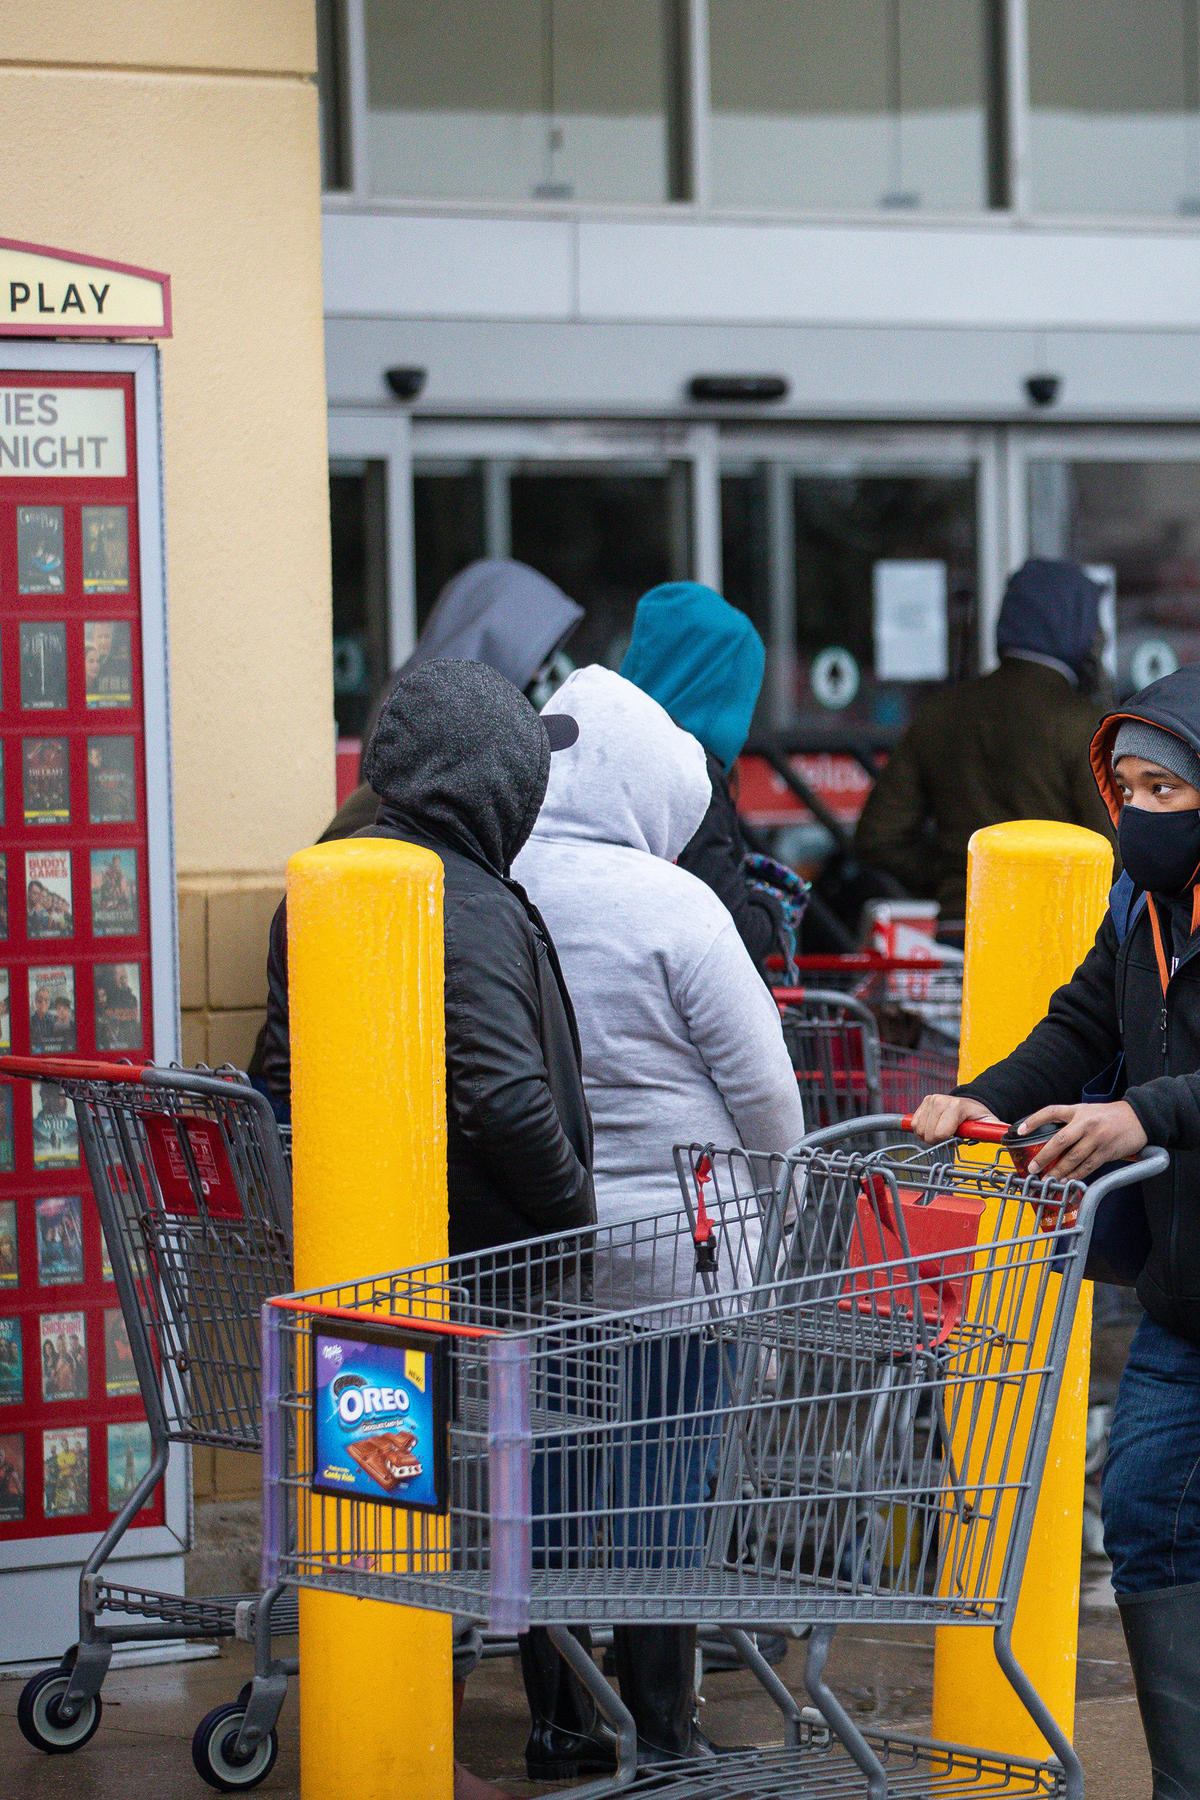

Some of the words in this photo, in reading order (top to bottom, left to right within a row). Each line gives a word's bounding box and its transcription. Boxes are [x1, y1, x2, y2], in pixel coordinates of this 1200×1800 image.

[10, 282, 111, 314] PLAY
[0, 392, 58, 426] IES
[0, 435, 108, 468] NIGHT
[28, 857, 67, 870] BUDDY
[29, 868, 68, 880] GAMES
[408, 1370, 424, 1385] NEW!
[338, 1387, 410, 1423] OREO
